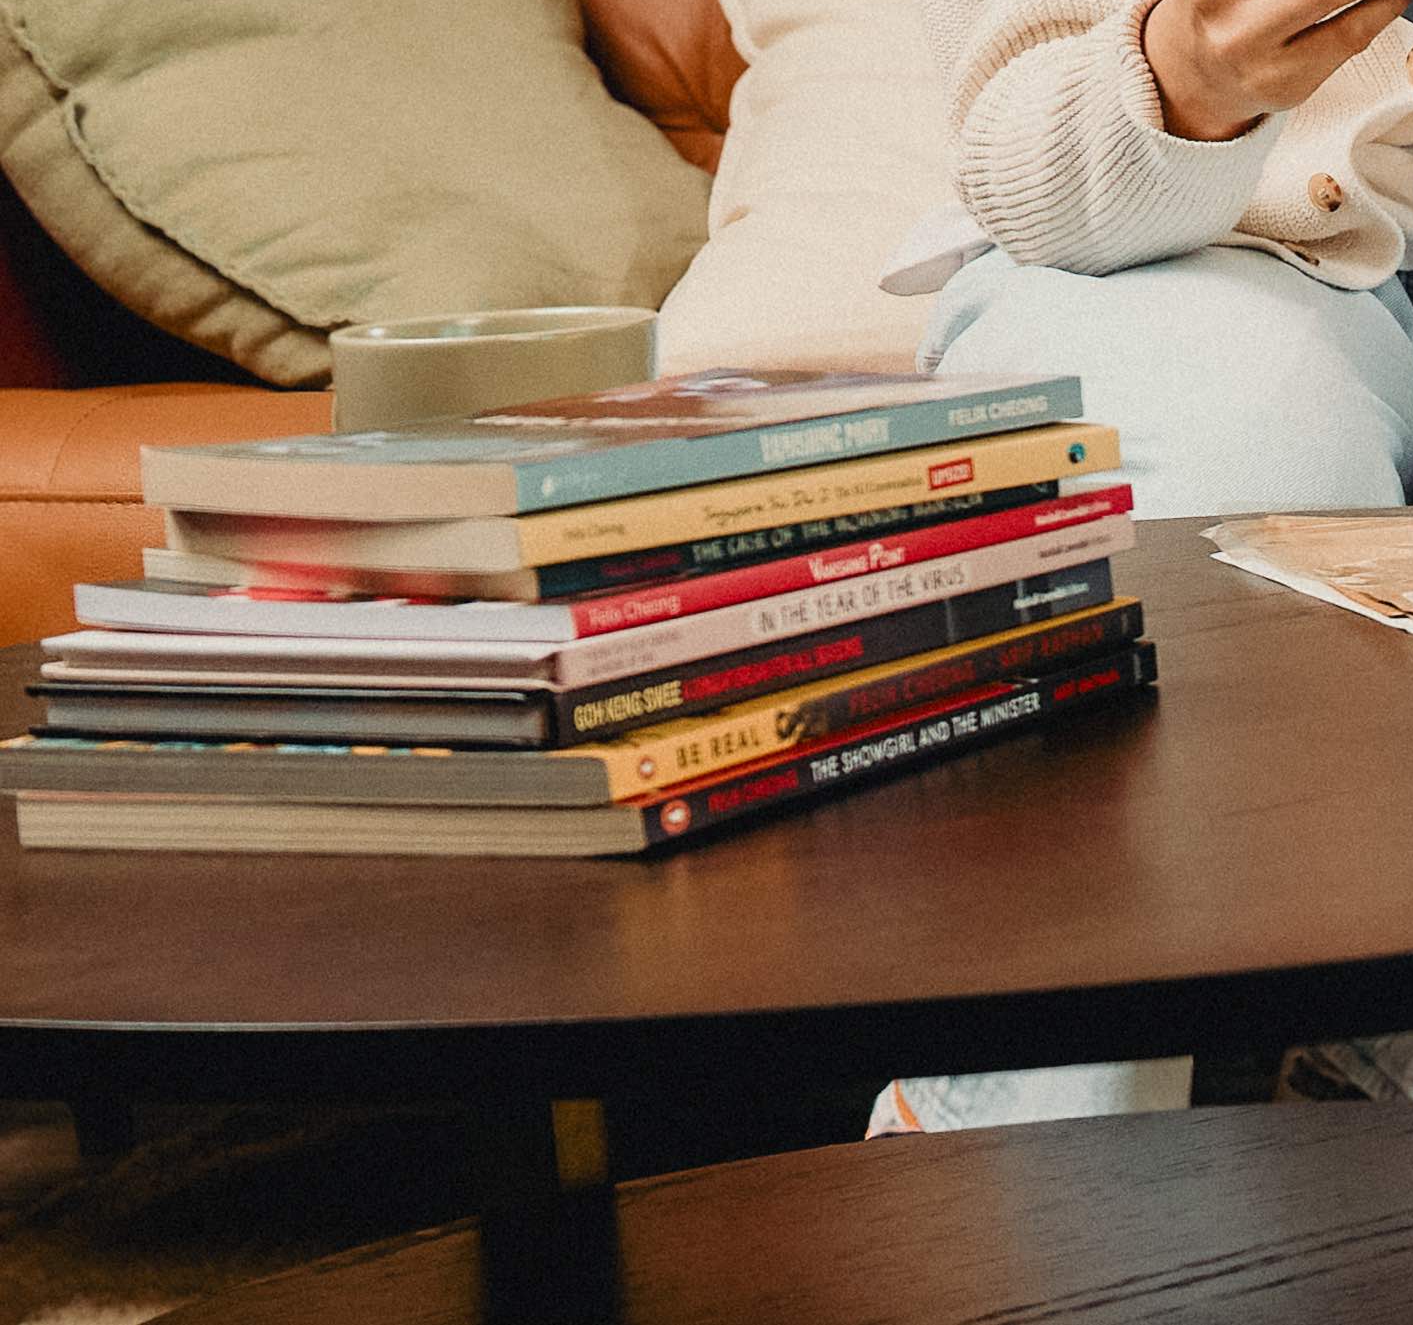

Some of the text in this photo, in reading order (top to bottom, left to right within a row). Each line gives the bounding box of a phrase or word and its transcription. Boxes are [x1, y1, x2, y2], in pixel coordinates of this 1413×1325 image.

[988, 394, 1049, 421] CHEONG
[692, 543, 724, 563] THE
[726, 534, 769, 557] CASE
[770, 527, 794, 548] OF
[799, 519, 833, 540] THE
[587, 595, 682, 628] Felix Cheong
[758, 563, 966, 633] IN THE YEAR OF THE VIRUS
[573, 679, 684, 732] GOH KENG SWEE
[675, 728, 761, 769] BE REAL
[810, 691, 1041, 782] THE SHOWGIRL AND THE MINISTER
